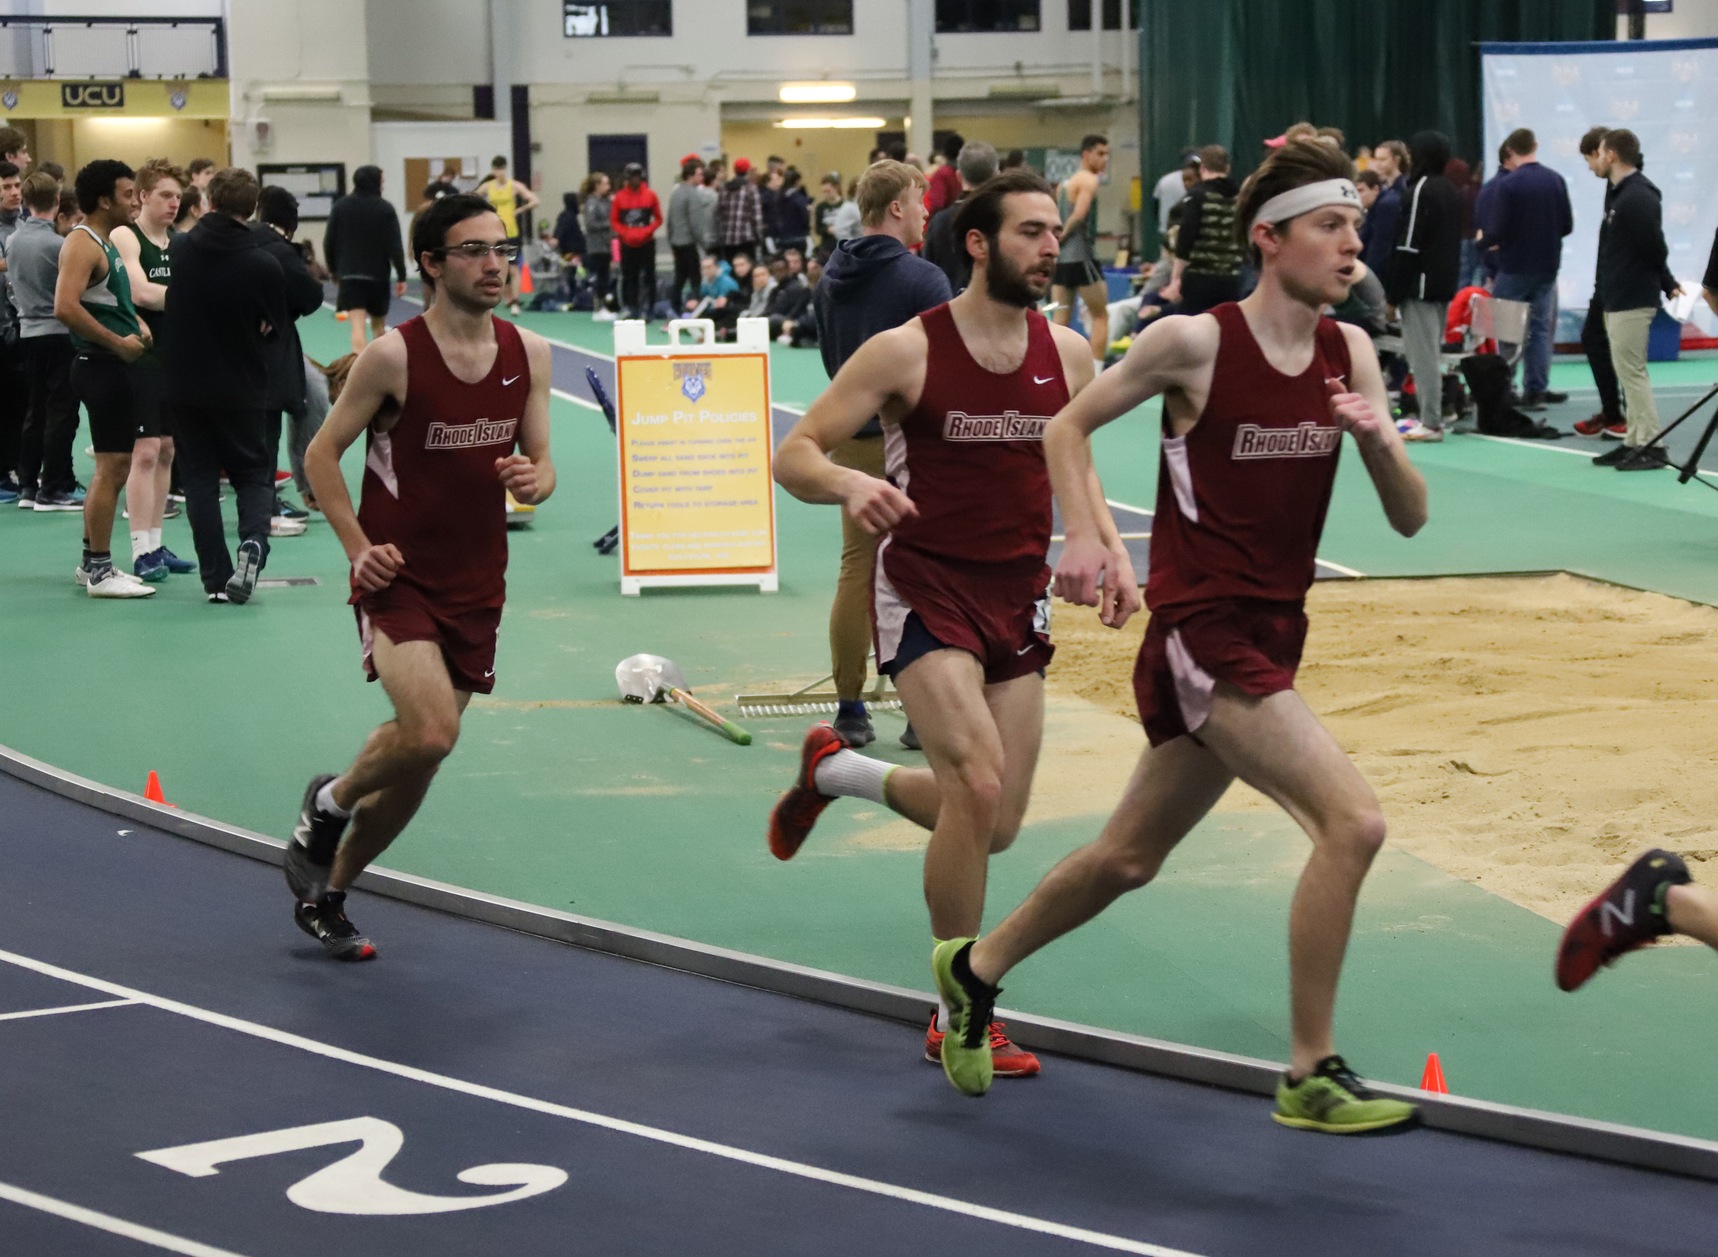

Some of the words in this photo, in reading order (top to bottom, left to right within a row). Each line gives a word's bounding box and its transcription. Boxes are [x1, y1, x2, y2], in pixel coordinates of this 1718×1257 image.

[64, 85, 121, 106] UCU
[631, 411, 669, 425] JUMP
[673, 410, 696, 424] PIT
[700, 410, 758, 423] POLICIES
[948, 415, 1000, 438] RHODE
[1004, 414, 1047, 437] ISLAN
[429, 424, 476, 446] RHODE
[1239, 428, 1298, 455] RHODE
[1300, 427, 1340, 452] ISL
[133, 1116, 569, 1215] 2
